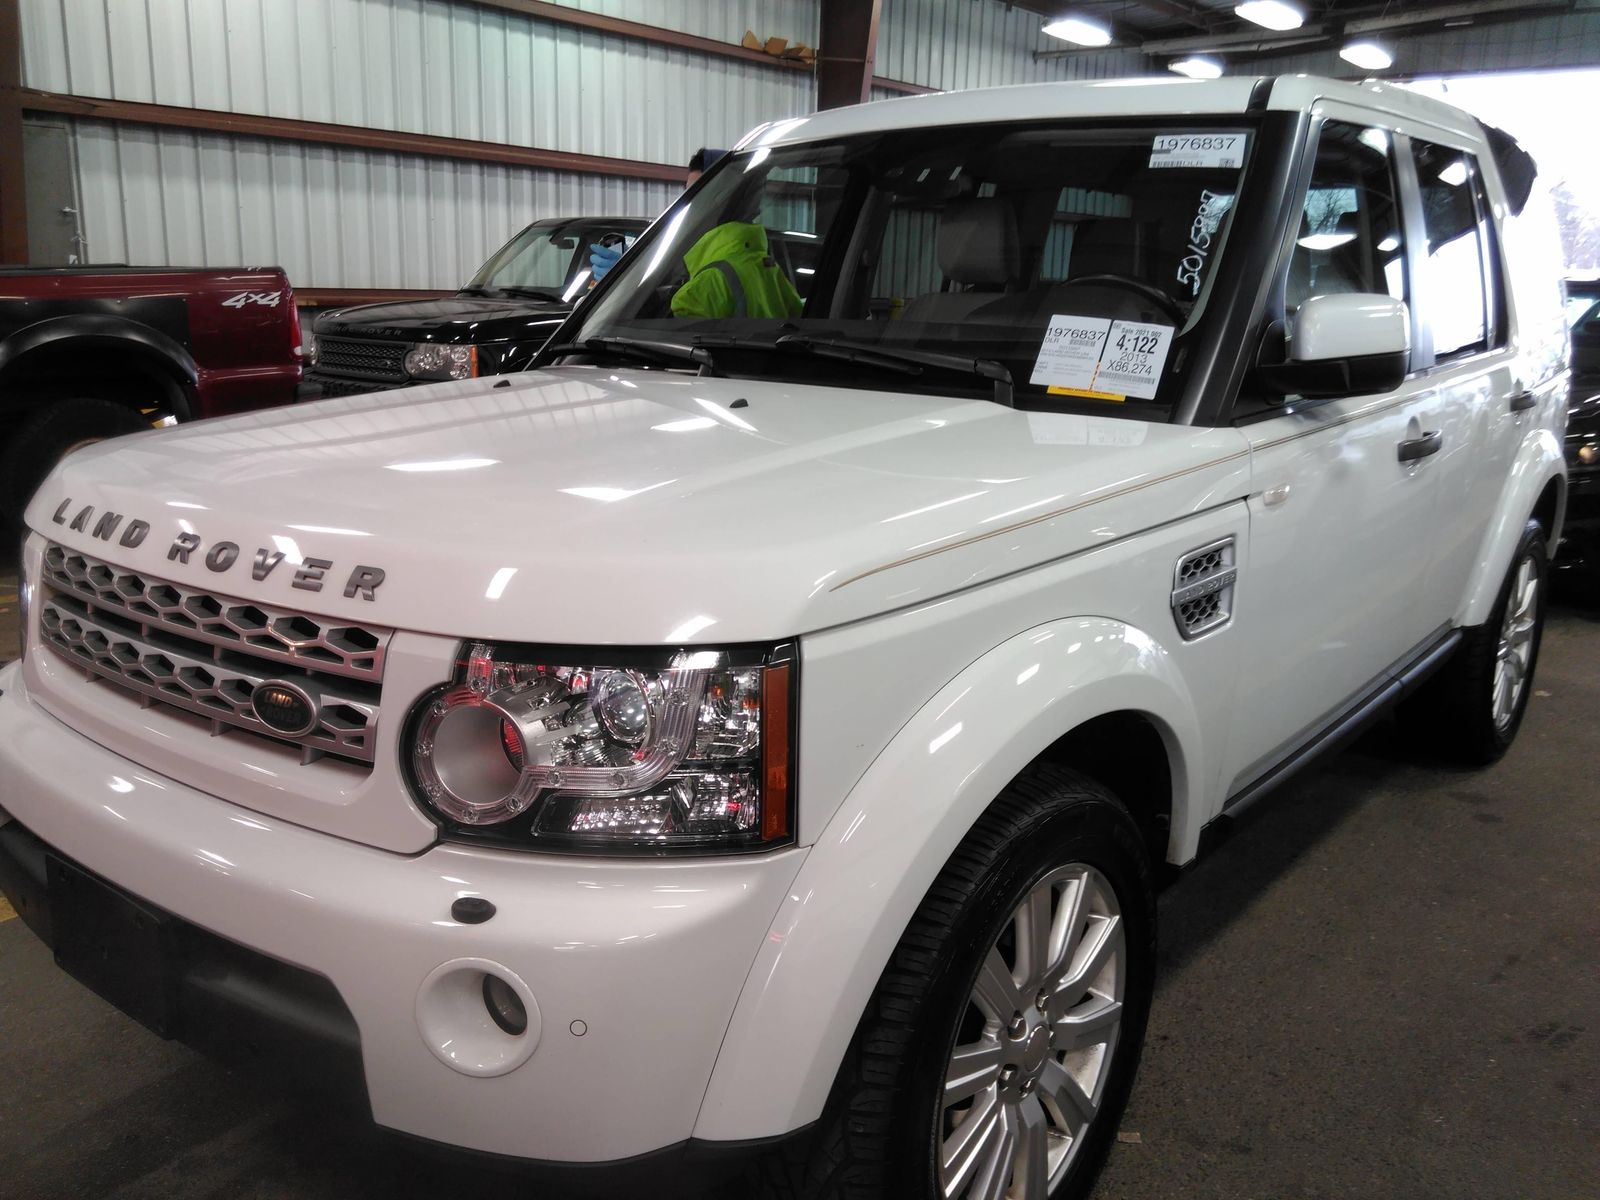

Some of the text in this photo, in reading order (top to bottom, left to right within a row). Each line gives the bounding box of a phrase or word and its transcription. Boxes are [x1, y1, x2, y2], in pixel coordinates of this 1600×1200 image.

[1158, 137, 1236, 150] 1976837
[1048, 327, 1106, 341] 1976837
[1116, 334, 1158, 354] 4:122
[1120, 351, 1148, 364] 2013
[53, 498, 386, 601] LAND ROVER
[264, 690, 293, 708] LAND
